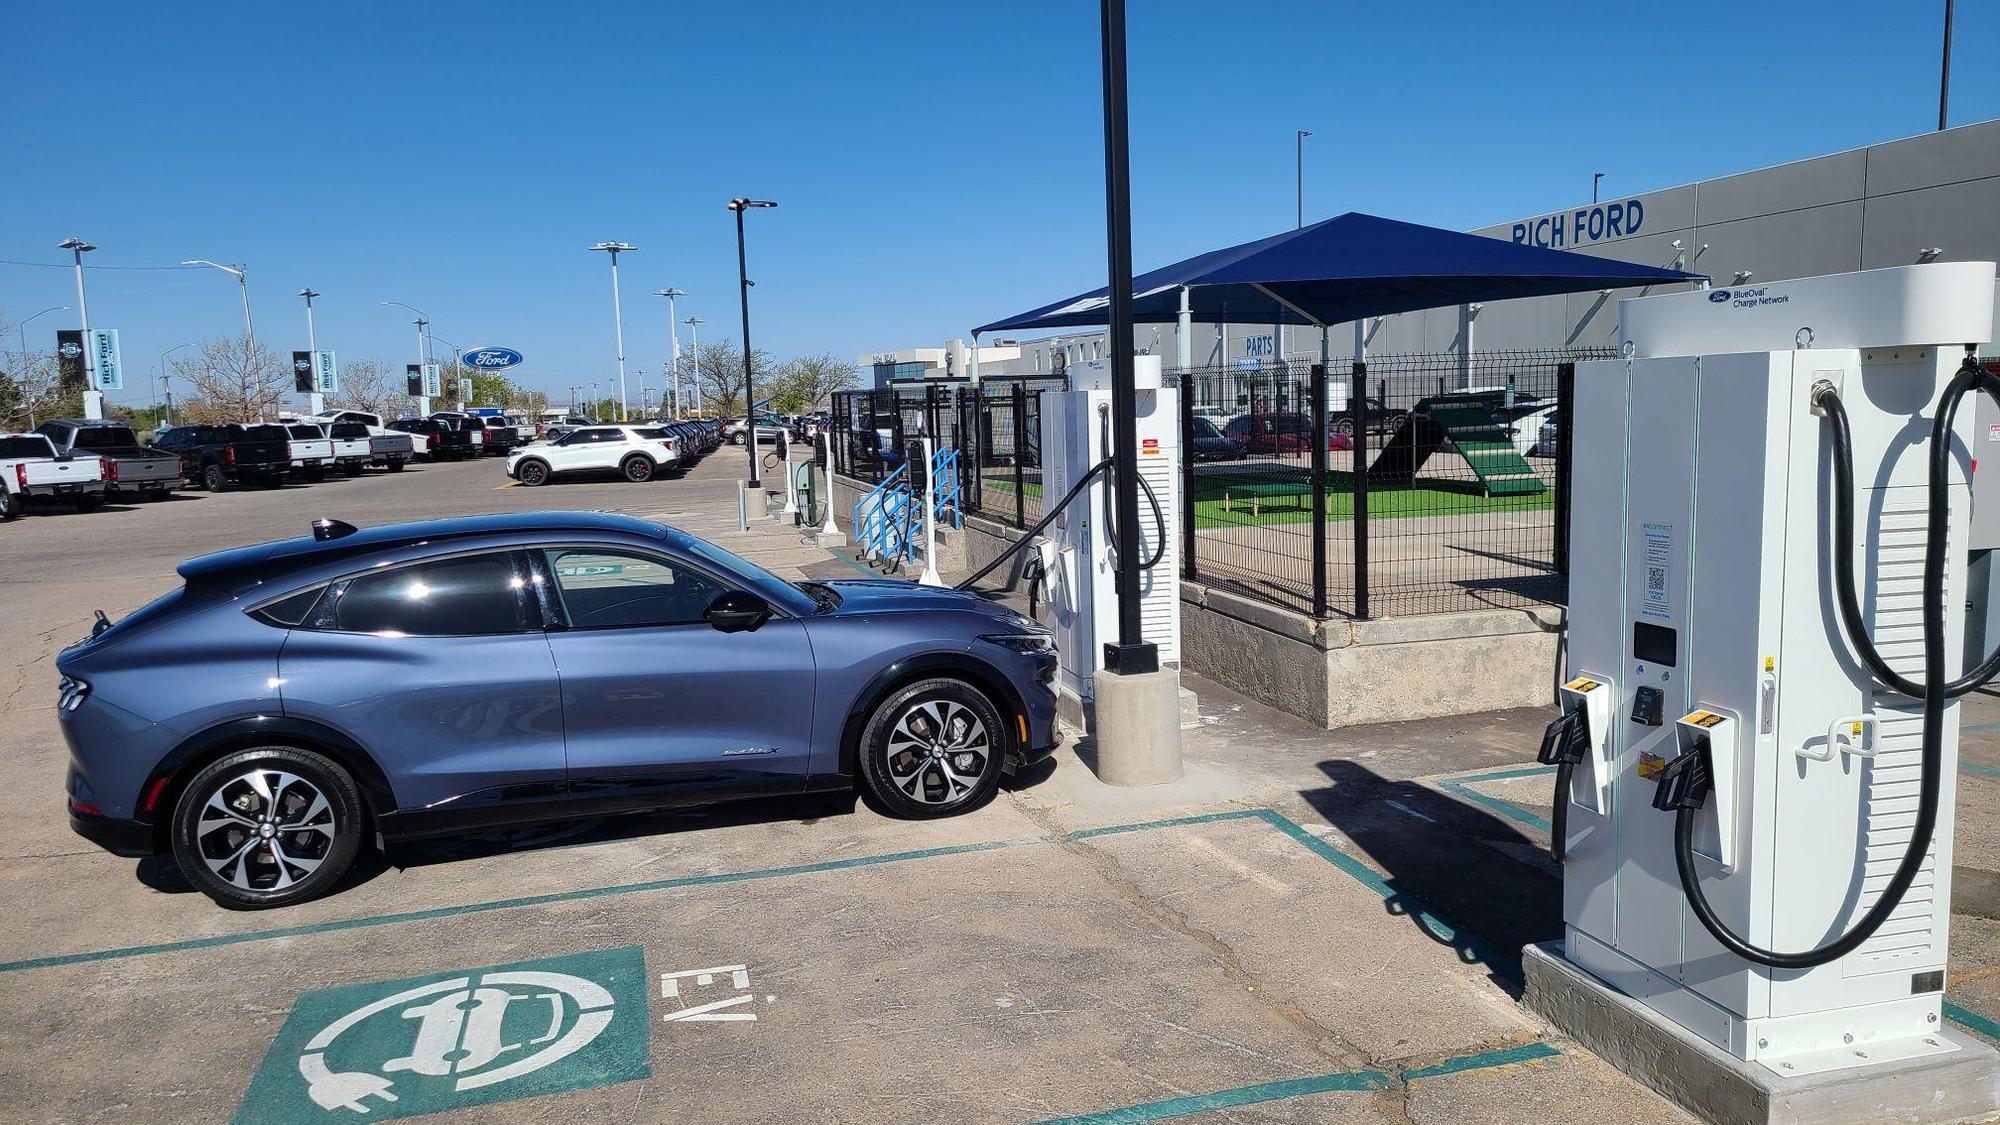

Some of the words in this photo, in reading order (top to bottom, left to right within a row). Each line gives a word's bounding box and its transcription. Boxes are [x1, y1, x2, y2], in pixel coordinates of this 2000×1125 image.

[1512, 214, 1564, 249] RICH
[1574, 200, 1644, 244] FORD
[1733, 298, 1758, 308] Charge
[1759, 294, 1789, 305] Network
[98, 334, 108, 359] Ford
[475, 351, 511, 365] Ford
[1246, 336, 1273, 357] PARTS
[102, 361, 110, 384] Rich
[661, 964, 757, 1022] EV
